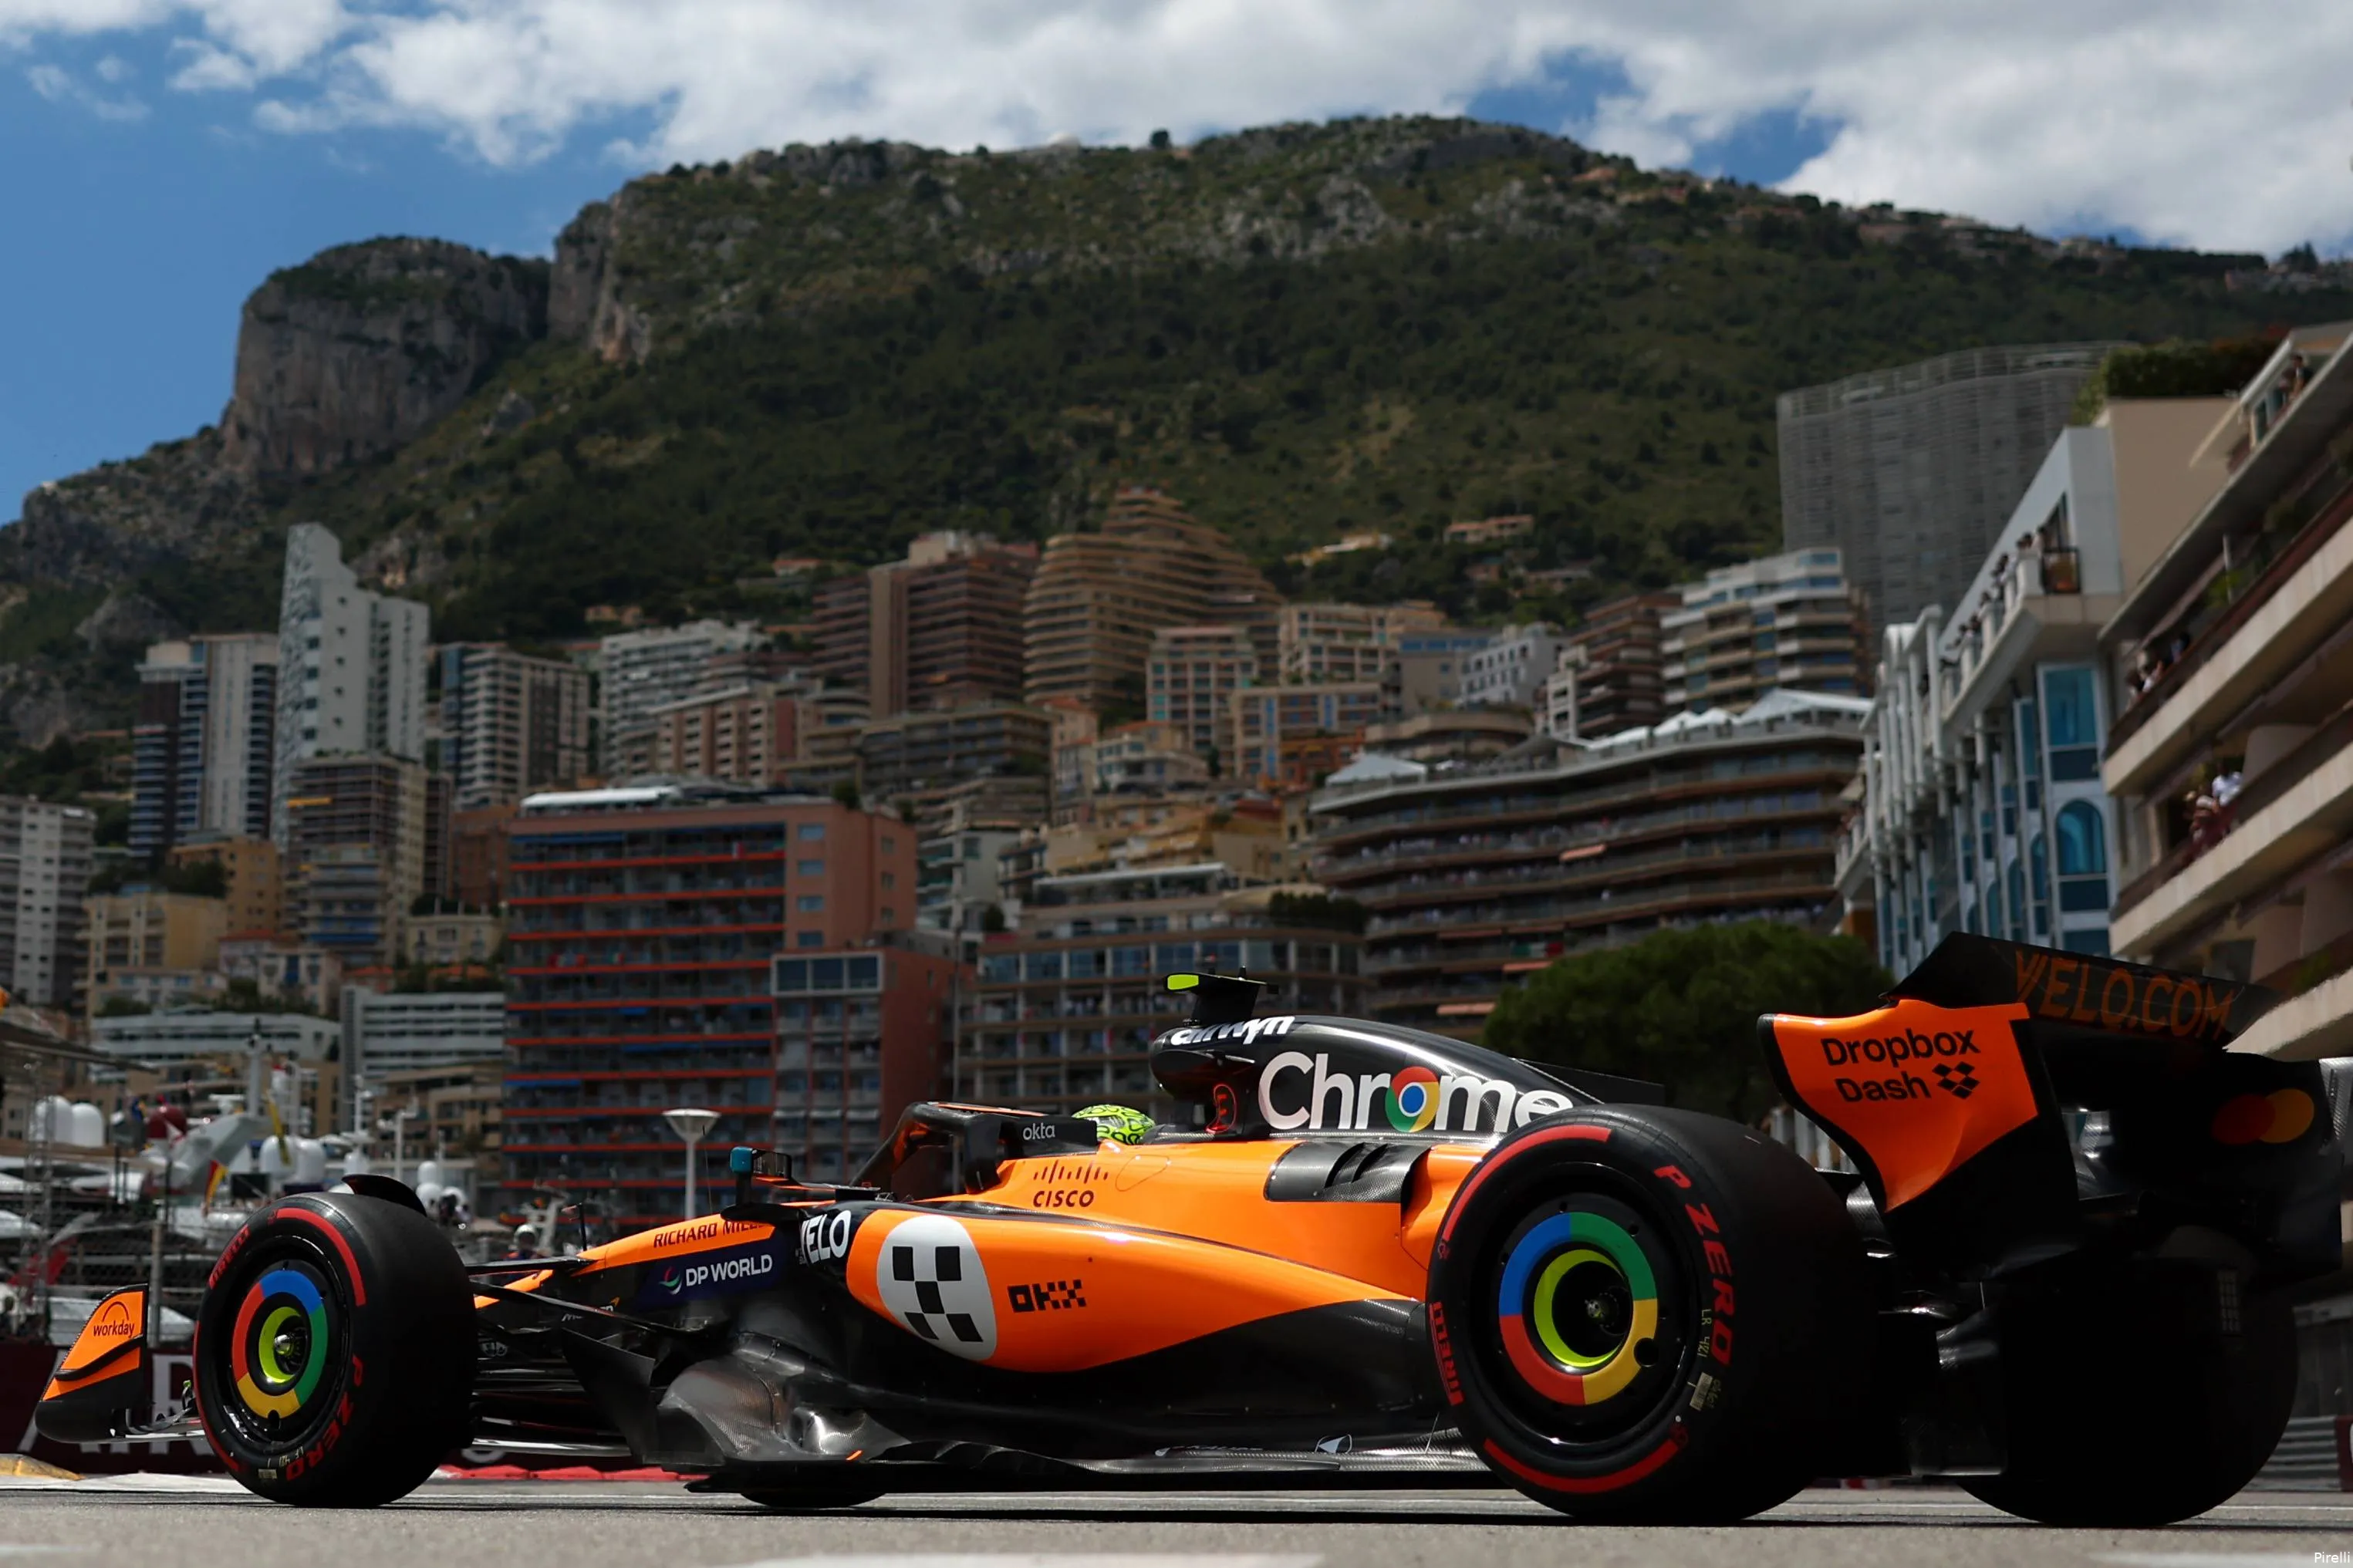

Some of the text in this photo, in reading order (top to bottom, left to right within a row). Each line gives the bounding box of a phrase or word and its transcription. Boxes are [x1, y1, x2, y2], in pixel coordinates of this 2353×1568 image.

[2015, 949, 2234, 1040] VELO.COM
[1820, 1028, 1980, 1067] Dropbox
[1258, 1051, 1574, 1132] Chrome
[1835, 1071, 1932, 1103] Dash
[1023, 1123, 1056, 1140] okta
[1032, 1189, 1094, 1208] CISCO
[653, 1222, 717, 1248] RICHARD
[686, 1266, 708, 1287] DP
[711, 1254, 772, 1282] WORLD
[1654, 1165, 1692, 1189] P
[1685, 1202, 1735, 1365] ZERO
[1008, 1279, 1086, 1313] OKX
[93, 1320, 134, 1338] workday
[286, 1391, 354, 1481] ZERO
